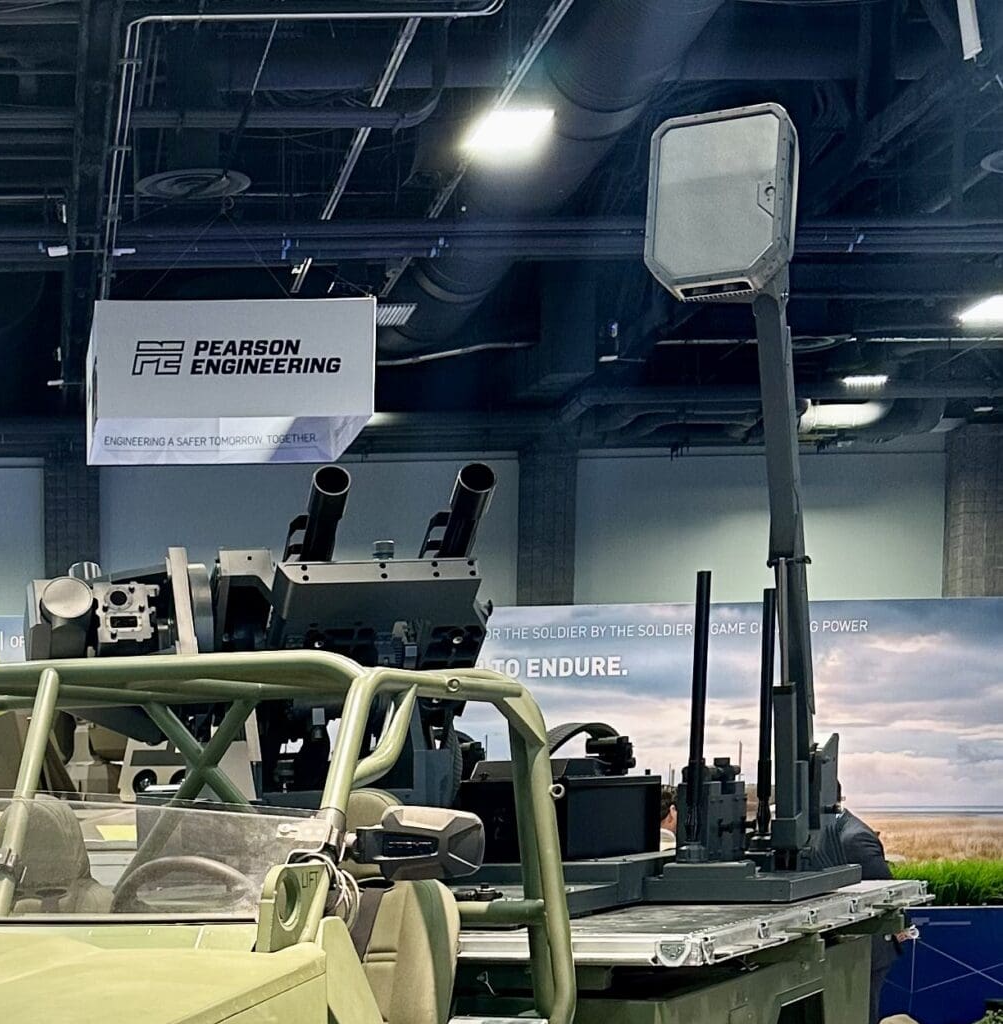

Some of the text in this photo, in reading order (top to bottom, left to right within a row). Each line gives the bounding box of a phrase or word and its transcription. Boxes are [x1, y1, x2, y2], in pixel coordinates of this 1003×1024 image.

[194, 339, 301, 356] PEARSON
[190, 357, 342, 375] ENGINEERING
[104, 435, 166, 446] ENGINEERING
[167, 436, 175, 446] A
[177, 436, 207, 446] SAFER
[486, 627, 501, 640] OR
[504, 627, 529, 640] THE
[533, 626, 587, 640] SOLDIER
[591, 625, 607, 638] BY
[610, 625, 634, 637] THE
[638, 624, 693, 637] SOLDIER
[710, 622, 746, 635] GAME
[822, 620, 869, 632] POWER
[491, 659, 520, 678] TO
[527, 656, 628, 678] ENDURE.
[301, 871, 318, 888] LIFT
